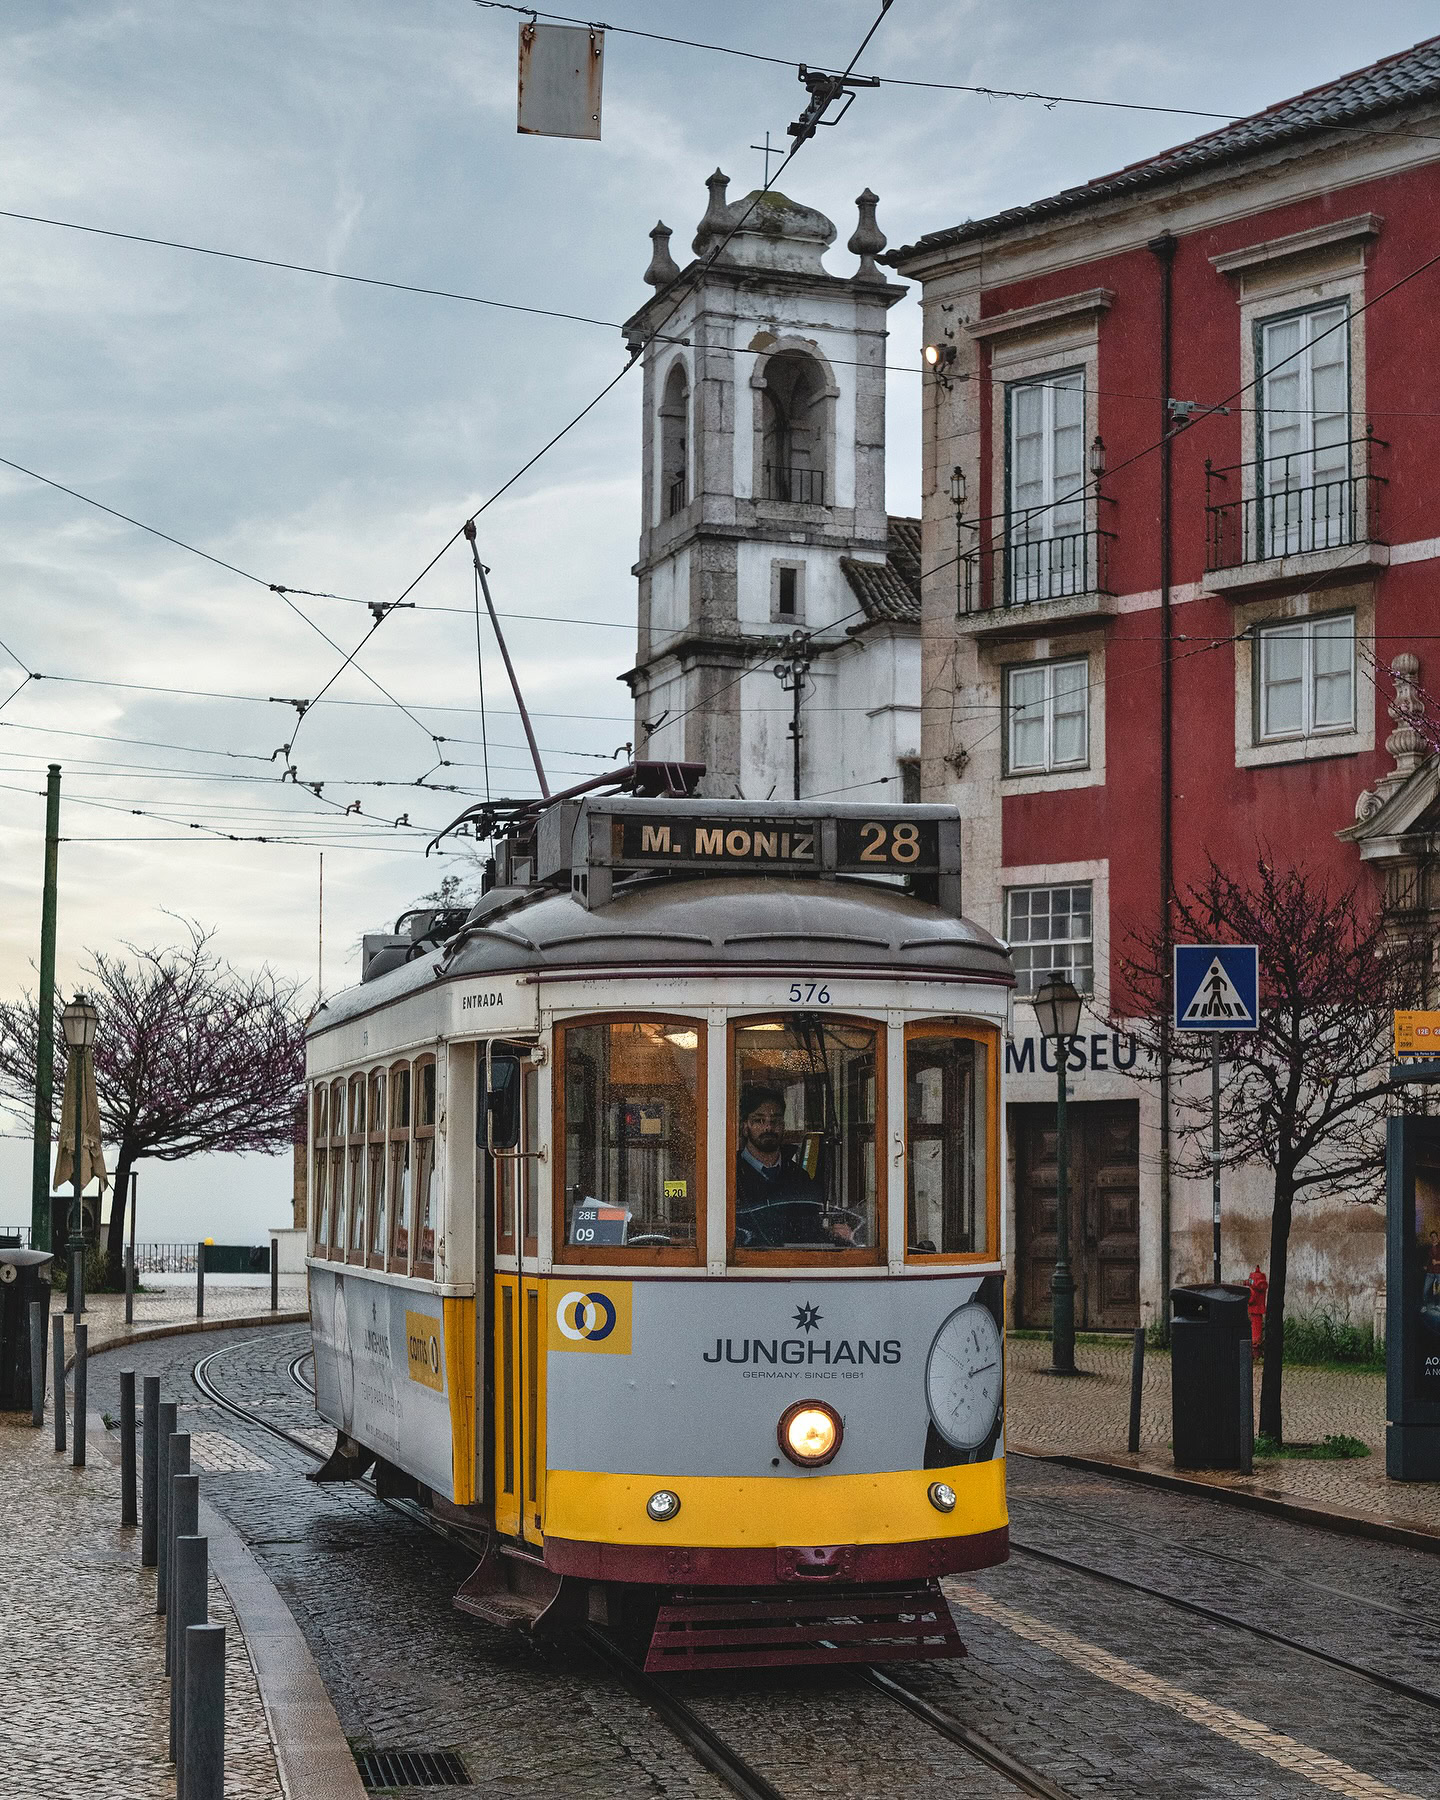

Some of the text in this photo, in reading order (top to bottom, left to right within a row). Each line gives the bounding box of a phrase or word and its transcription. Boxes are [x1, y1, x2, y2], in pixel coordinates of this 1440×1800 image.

[641, 825, 814, 860] M. MONIZ
[859, 822, 921, 863] 28
[462, 993, 504, 1010] ENTRADA
[789, 983, 831, 1004] 576
[1006, 1033, 1137, 1074] MUSEU
[664, 1189, 683, 1198] 3.20
[578, 1211, 597, 1221] 28E
[576, 1228, 595, 1242] 09
[703, 1338, 901, 1364] JUNGHANS
[1425, 1357, 1440, 1365] AO
[804, 1371, 837, 1379] SINCE
